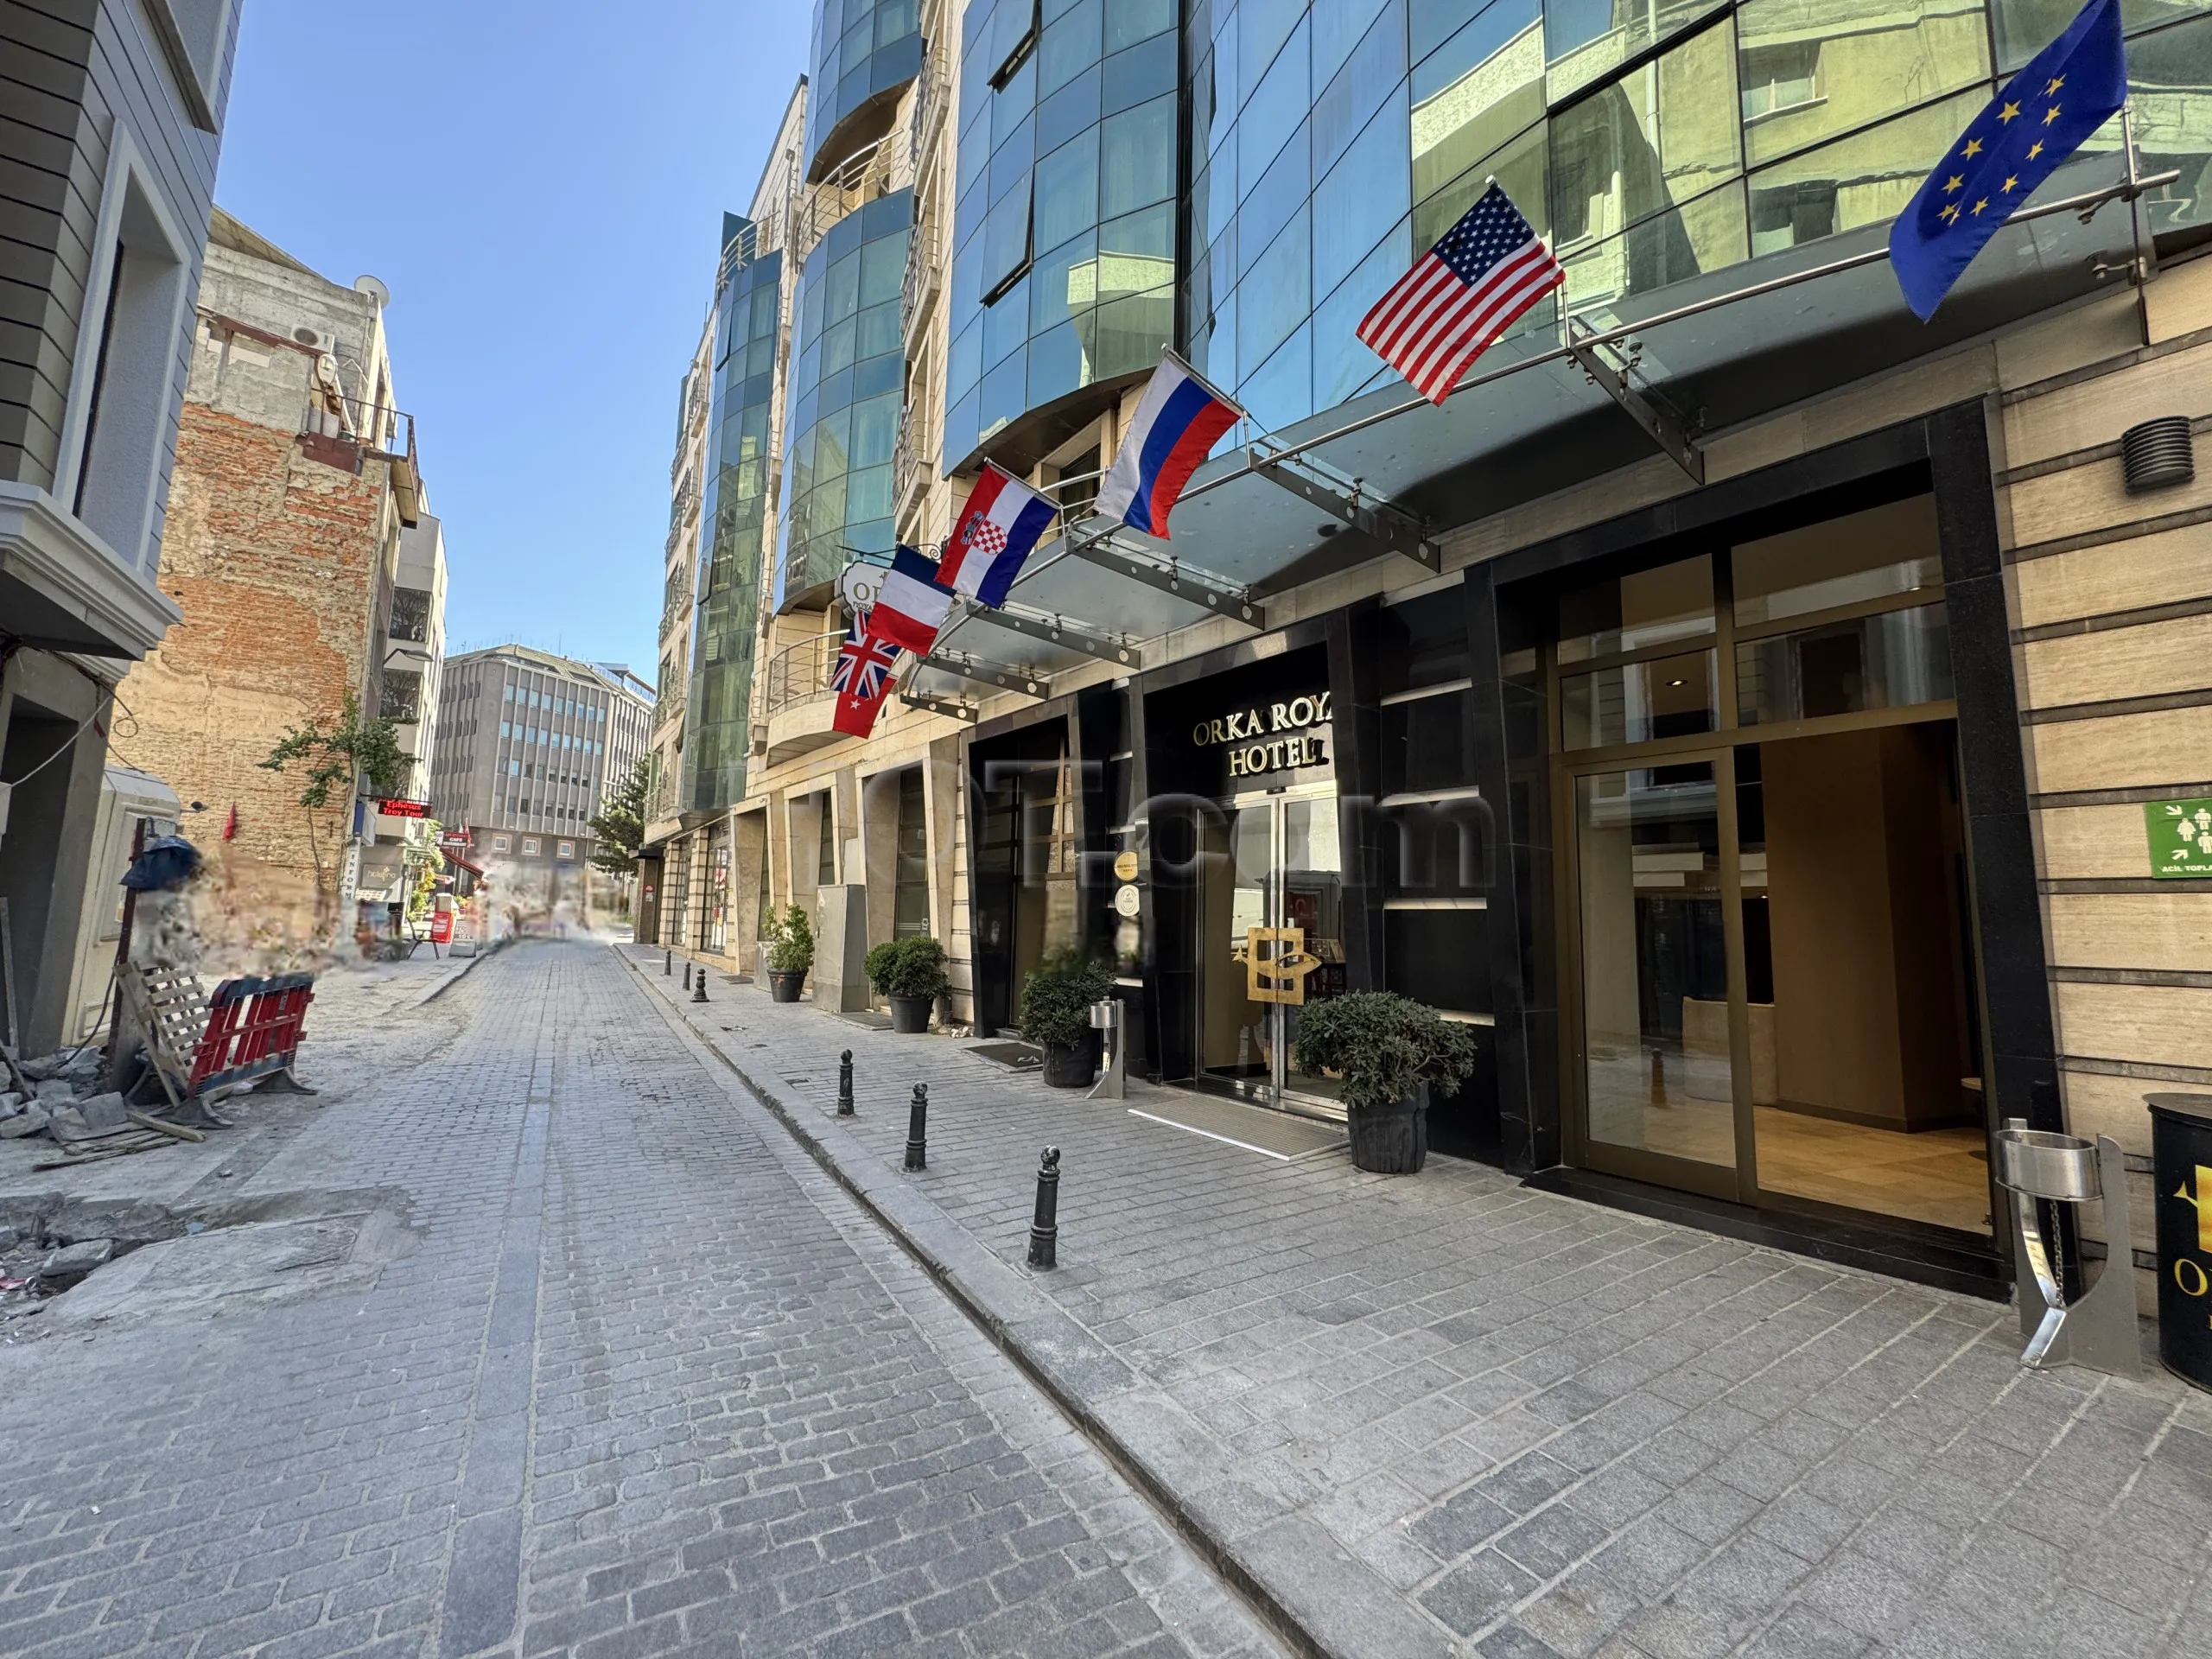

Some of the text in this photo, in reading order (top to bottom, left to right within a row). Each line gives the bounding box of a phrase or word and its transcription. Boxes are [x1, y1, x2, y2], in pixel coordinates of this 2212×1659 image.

[1193, 709, 1264, 747] ORKA
[1229, 736, 1317, 777] HOTEL
[384, 807, 403, 817] Troy
[386, 800, 422, 810] Ephesus
